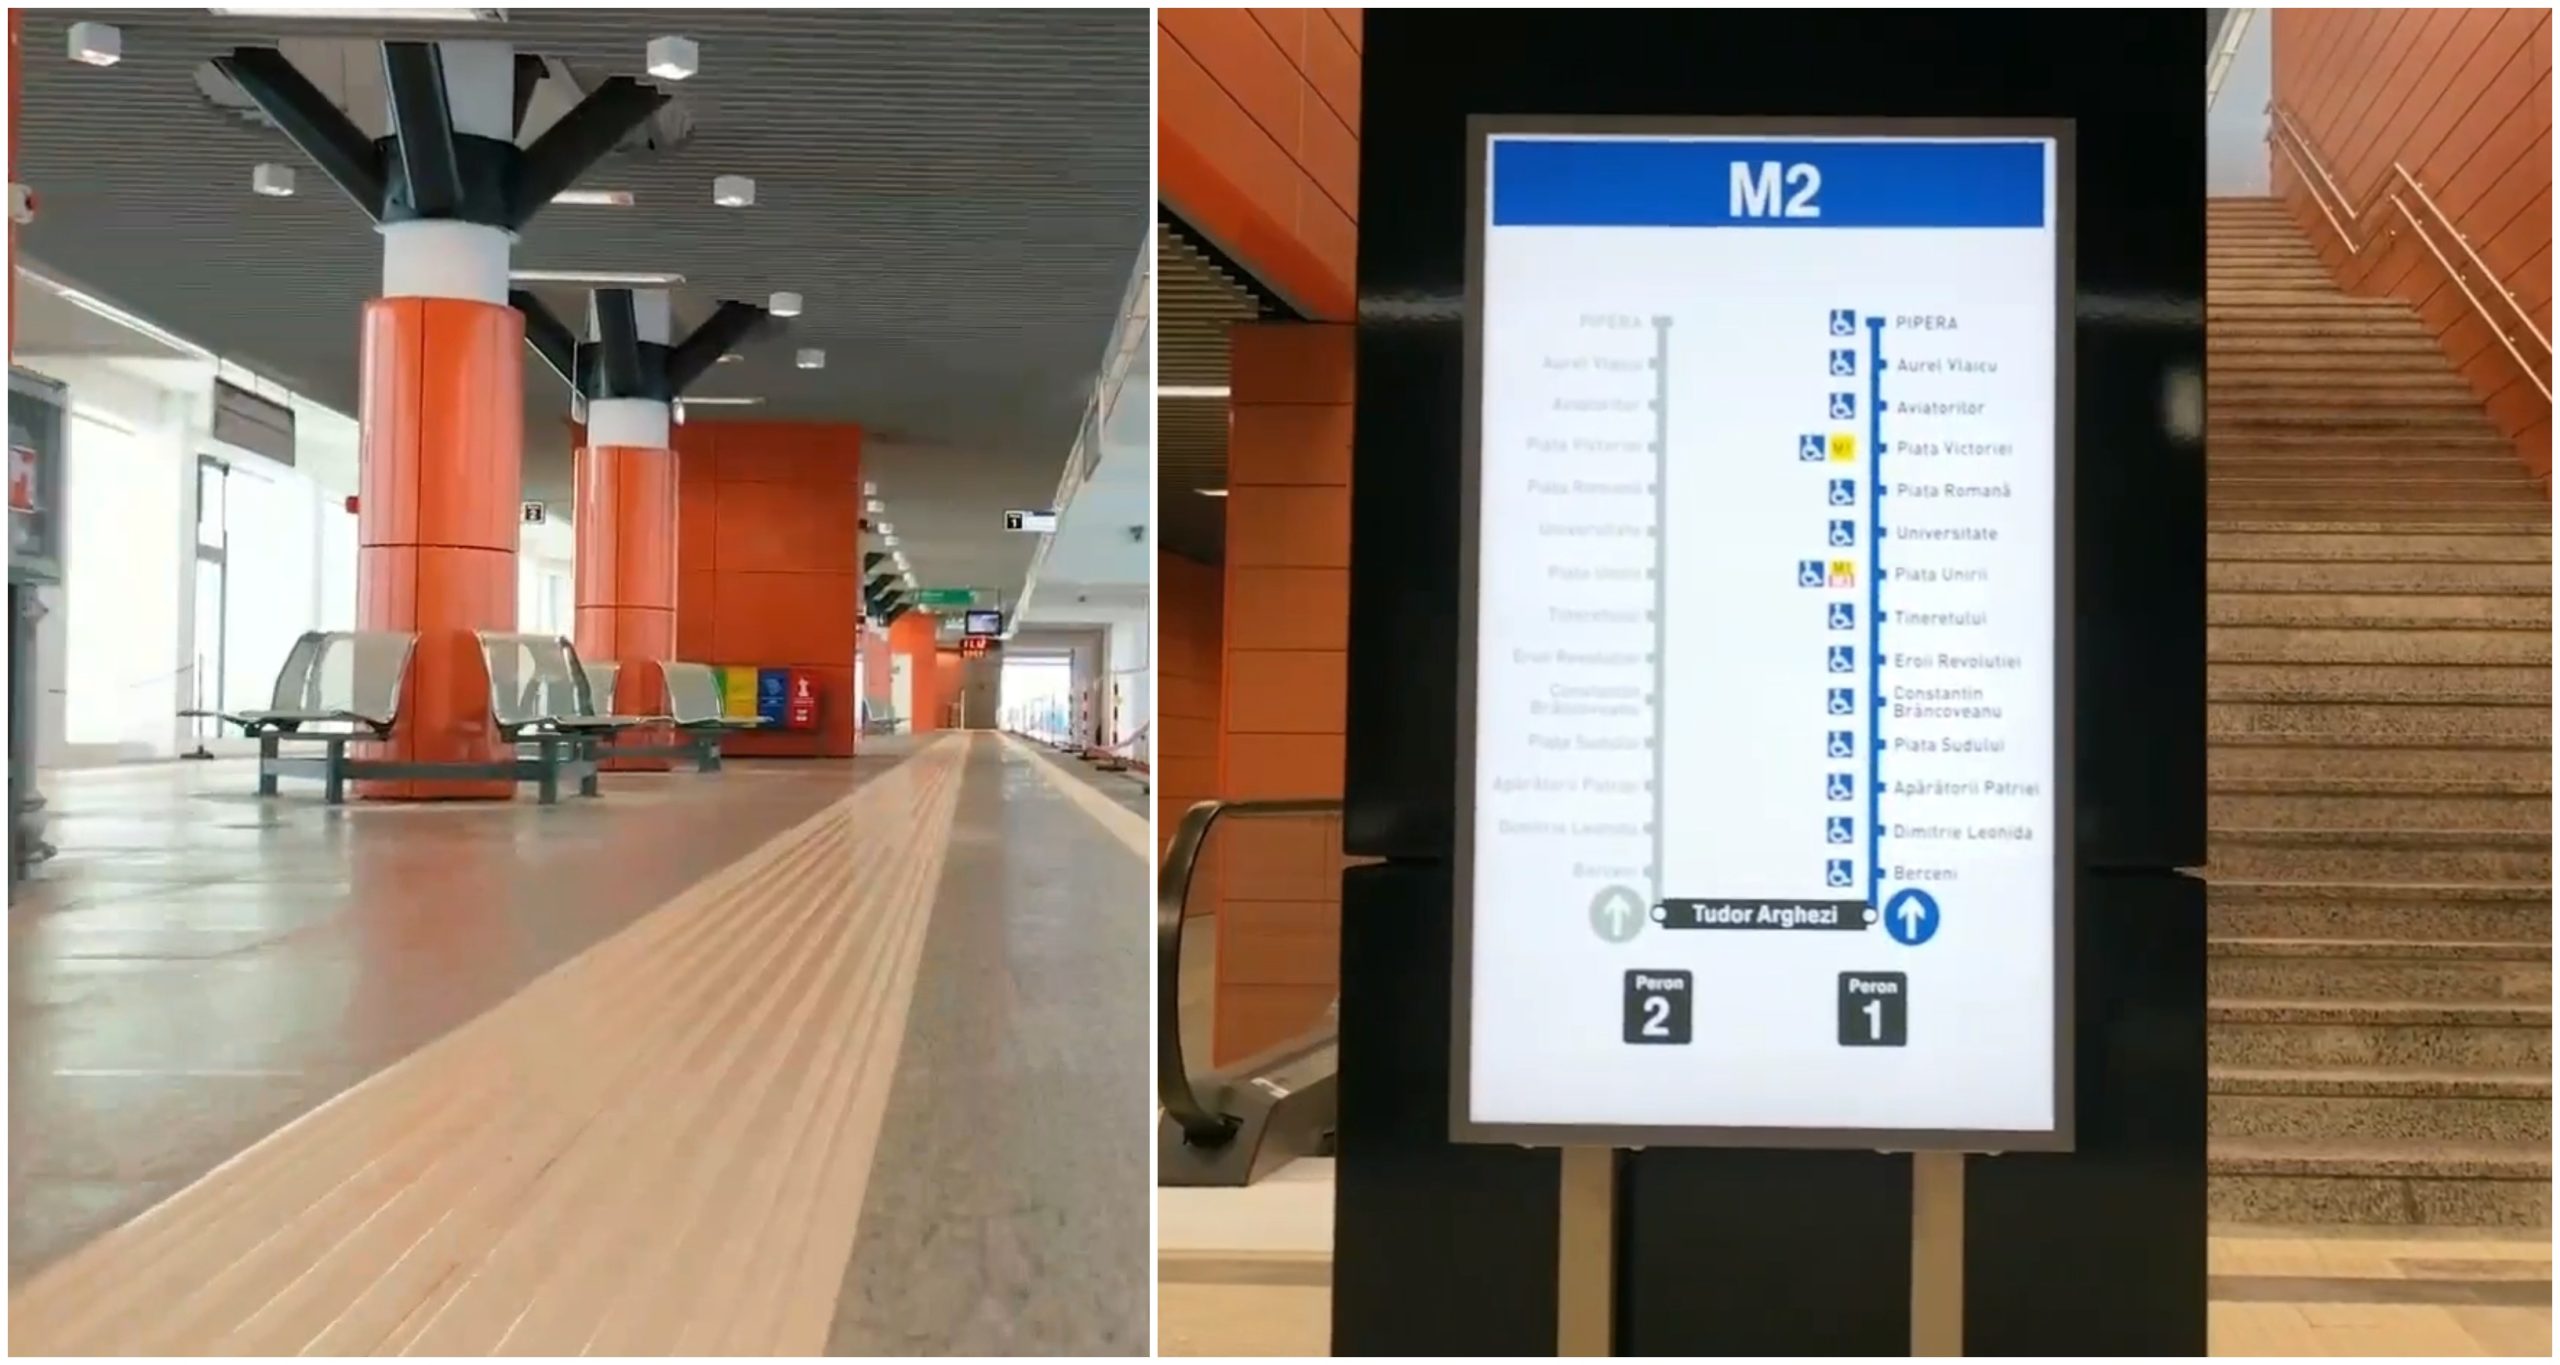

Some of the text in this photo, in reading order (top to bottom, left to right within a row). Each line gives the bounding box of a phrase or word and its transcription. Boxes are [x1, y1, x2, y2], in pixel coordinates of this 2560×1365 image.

[1730, 161, 1821, 217] M2
[1896, 315, 1958, 331] PIPERA
[1897, 358, 1997, 373] Aurel Vlaicu
[1897, 401, 1985, 415] Aviatorilor
[1943, 441, 2013, 456] Victoriei
[1944, 483, 2011, 498] Romană
[1897, 526, 1998, 541] Universitate
[1941, 568, 1988, 582] Unirii
[1895, 610, 1987, 626] Tineretului
[1894, 653, 1933, 668] Eroii
[1894, 685, 1983, 701] Constantin
[1894, 703, 2002, 719] Brâncoveanu
[1942, 737, 2005, 753] Sudului
[1894, 780, 2038, 797] Apărătorii Patriei
[1893, 823, 2033, 840] Dimitrie Leonida
[1894, 865, 1957, 881] Berceni
[1692, 904, 1838, 927] Tudor Arghezi
[1636, 975, 1684, 991] Peron
[1849, 978, 1897, 994] Peron
[1642, 996, 1670, 1036] 2
[1863, 999, 1881, 1039] 1
